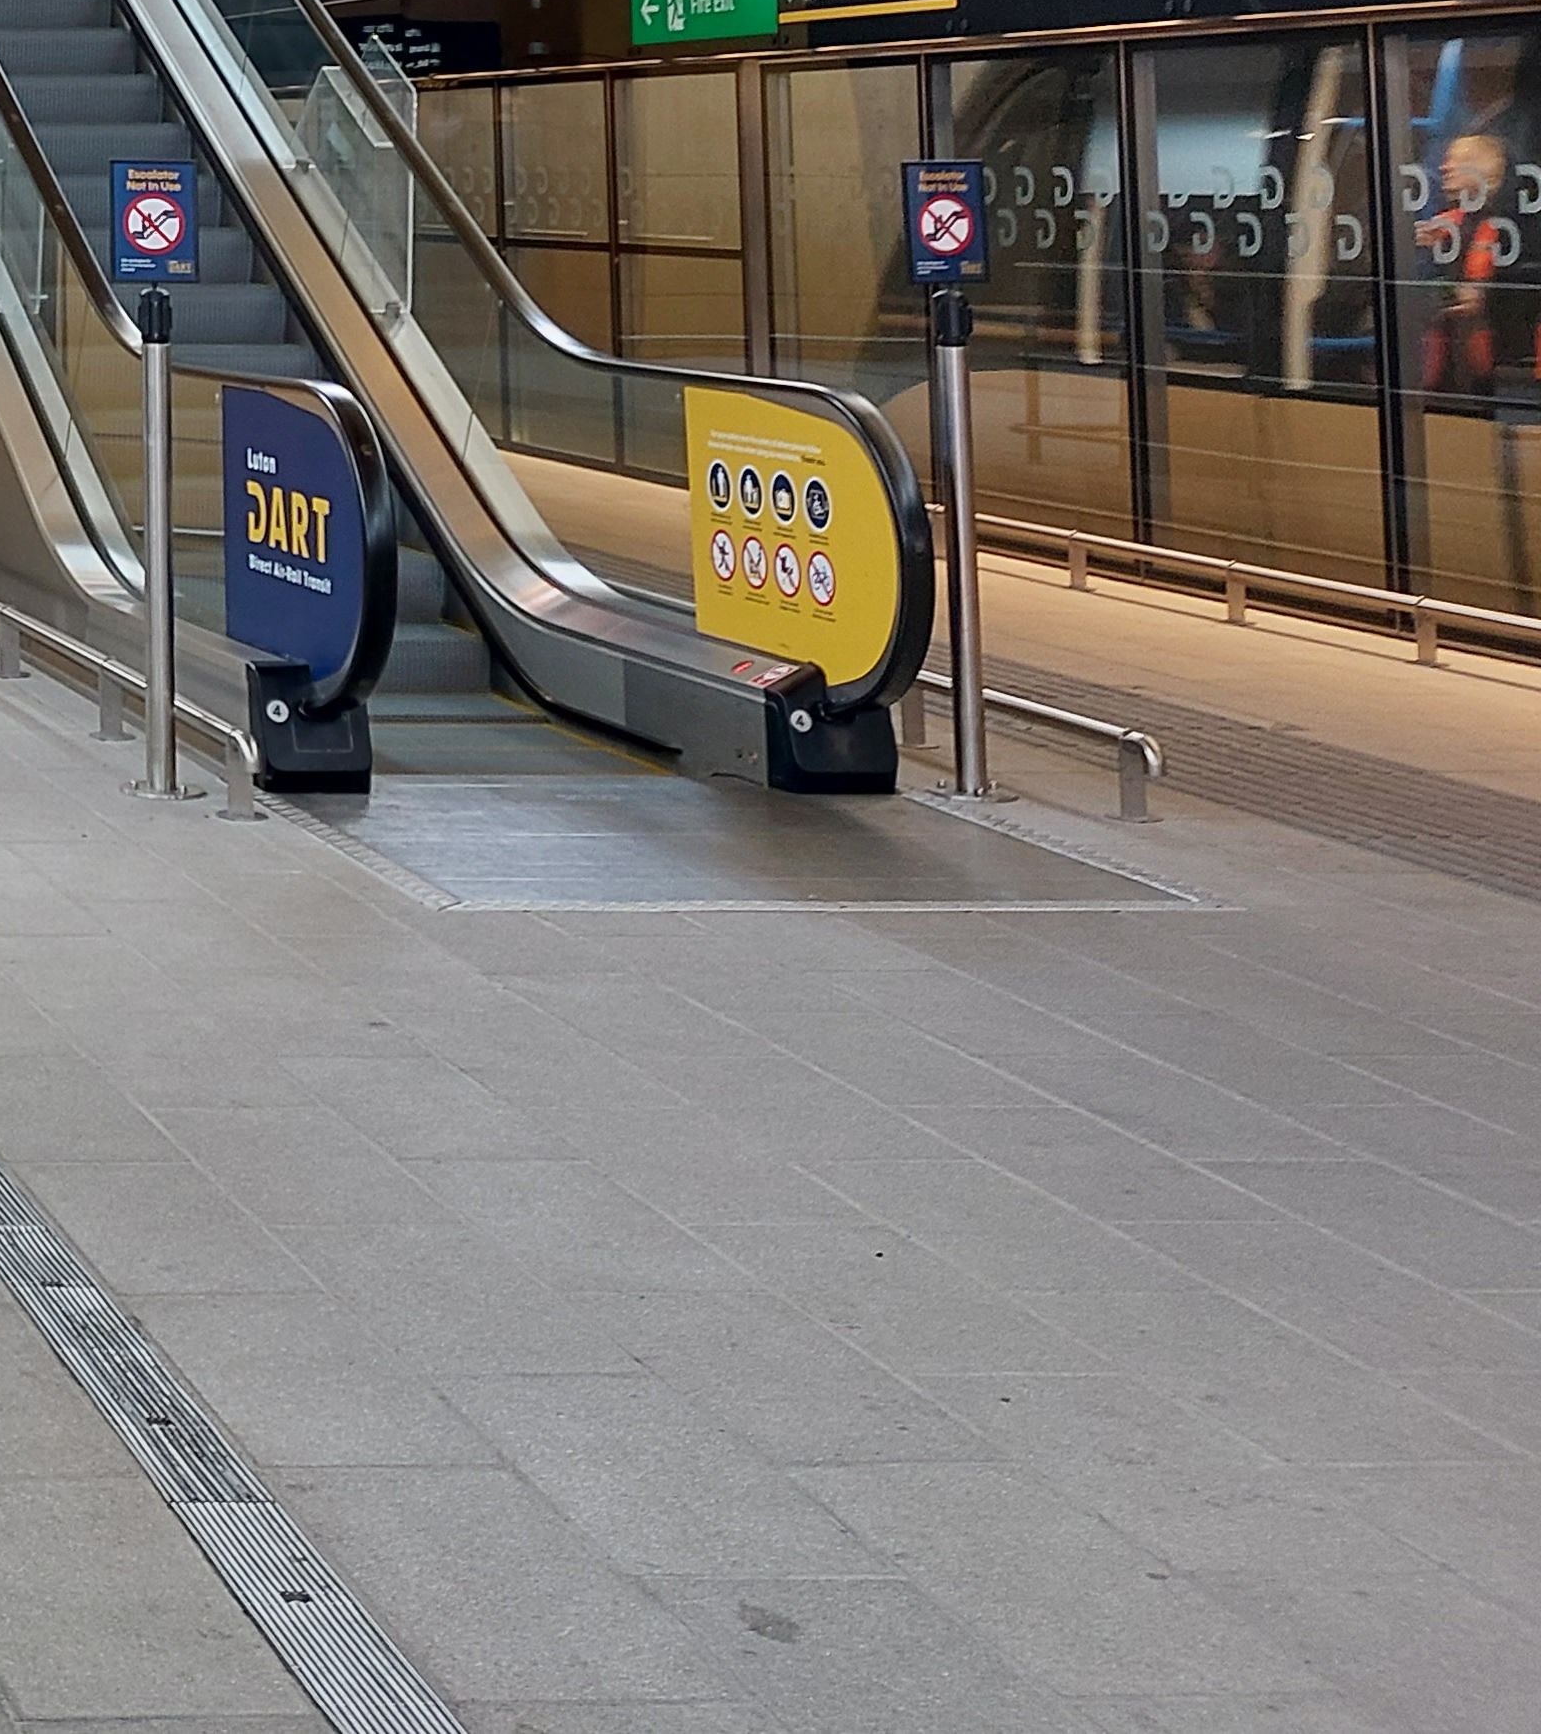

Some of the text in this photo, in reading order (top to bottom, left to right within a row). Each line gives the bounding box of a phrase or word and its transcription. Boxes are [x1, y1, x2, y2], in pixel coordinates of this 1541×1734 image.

[128, 169, 180, 181] Escalator
[126, 181, 146, 191] Not
[160, 181, 182, 192] Use
[246, 447, 277, 474] Luton
[246, 479, 330, 564] DART
[248, 553, 333, 595] Direct Air-Rail Transit
[272, 704, 282, 717] 4
[795, 715, 805, 727] 4
